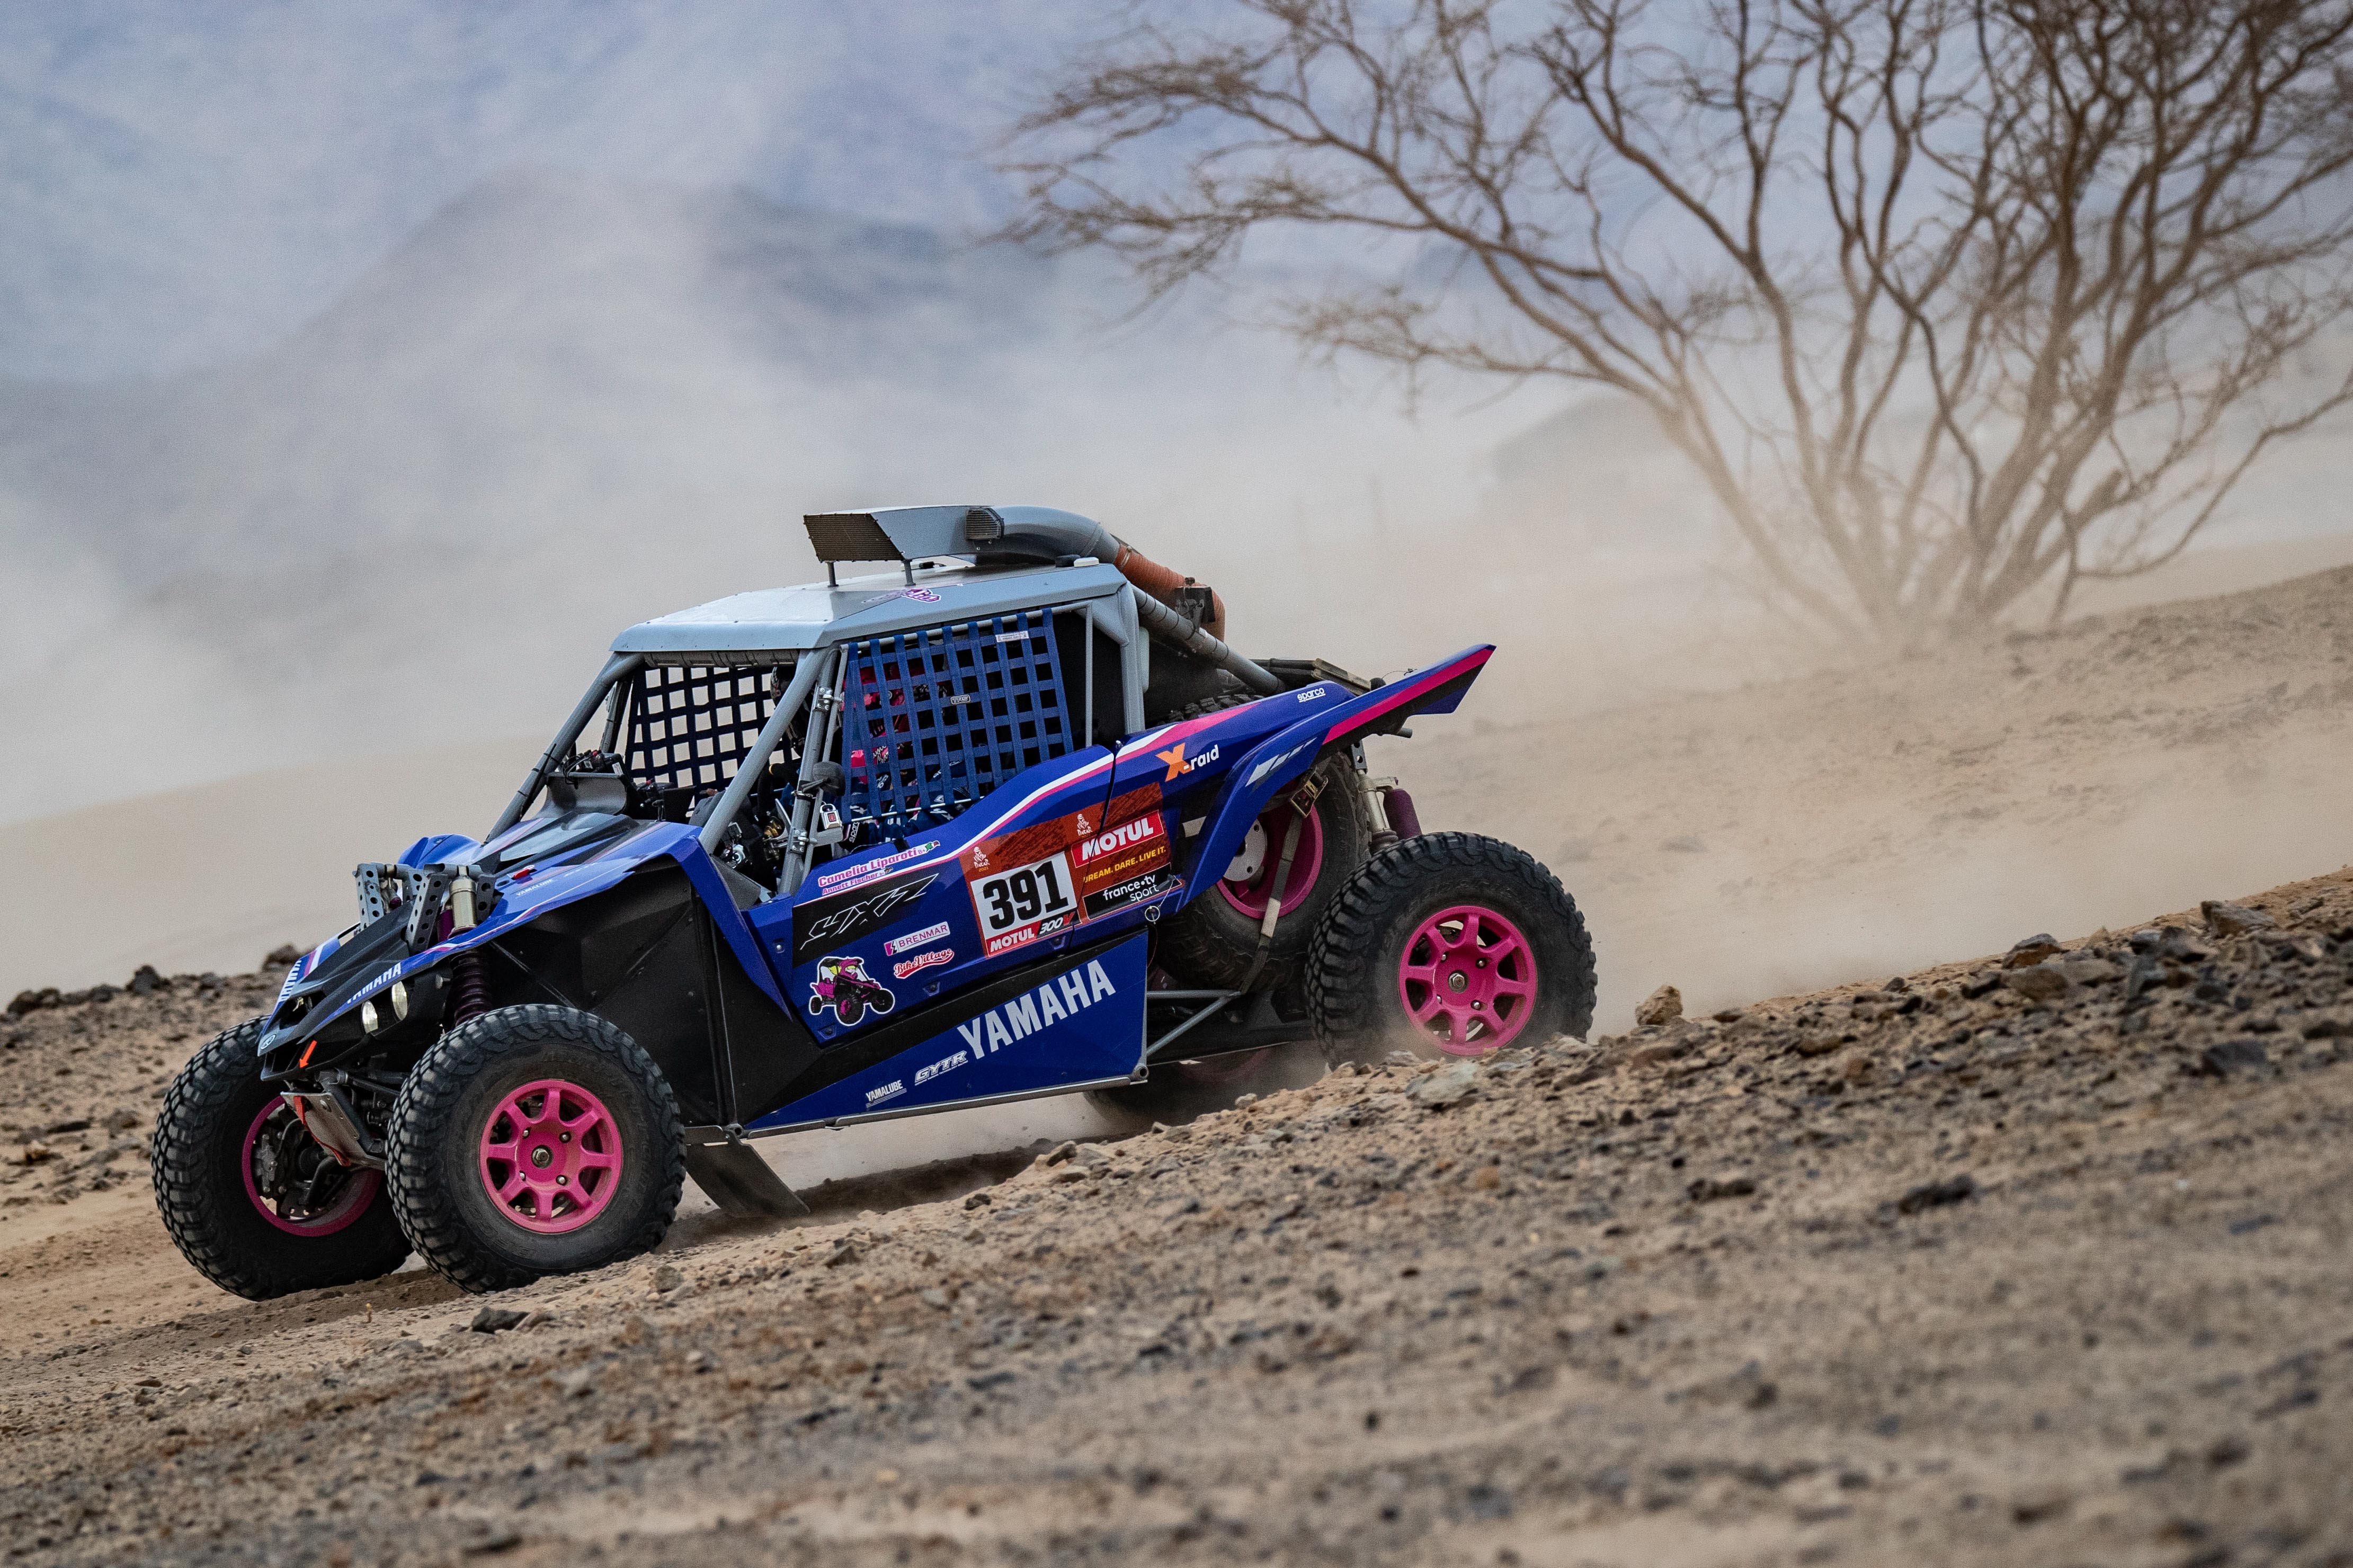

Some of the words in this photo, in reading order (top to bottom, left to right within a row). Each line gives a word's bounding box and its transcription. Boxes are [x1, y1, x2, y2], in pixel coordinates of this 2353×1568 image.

[1297, 687, 1325, 702] sparco
[1155, 742, 1219, 781] X-raid
[849, 821, 860, 843] spar
[1082, 818, 1154, 861] MOTUL
[819, 865, 868, 886] Camelia
[871, 848, 917, 869] Liparoti
[1115, 858, 1138, 872] DARE.
[1139, 849, 1156, 862] LIVE
[1157, 846, 1166, 854] IT.
[823, 882, 849, 894] Annett
[850, 873, 878, 885] Fischer
[983, 860, 1069, 930] 391
[1130, 884, 1160, 901] sport
[1039, 911, 1076, 935] 300V
[898, 925, 948, 947] BRENMAR
[990, 928, 1035, 952] MOTUL
[957, 959, 1116, 1060] YAMAHA
[915, 1050, 967, 1083] GYTR
[866, 1080, 903, 1101] YAMALUBE
